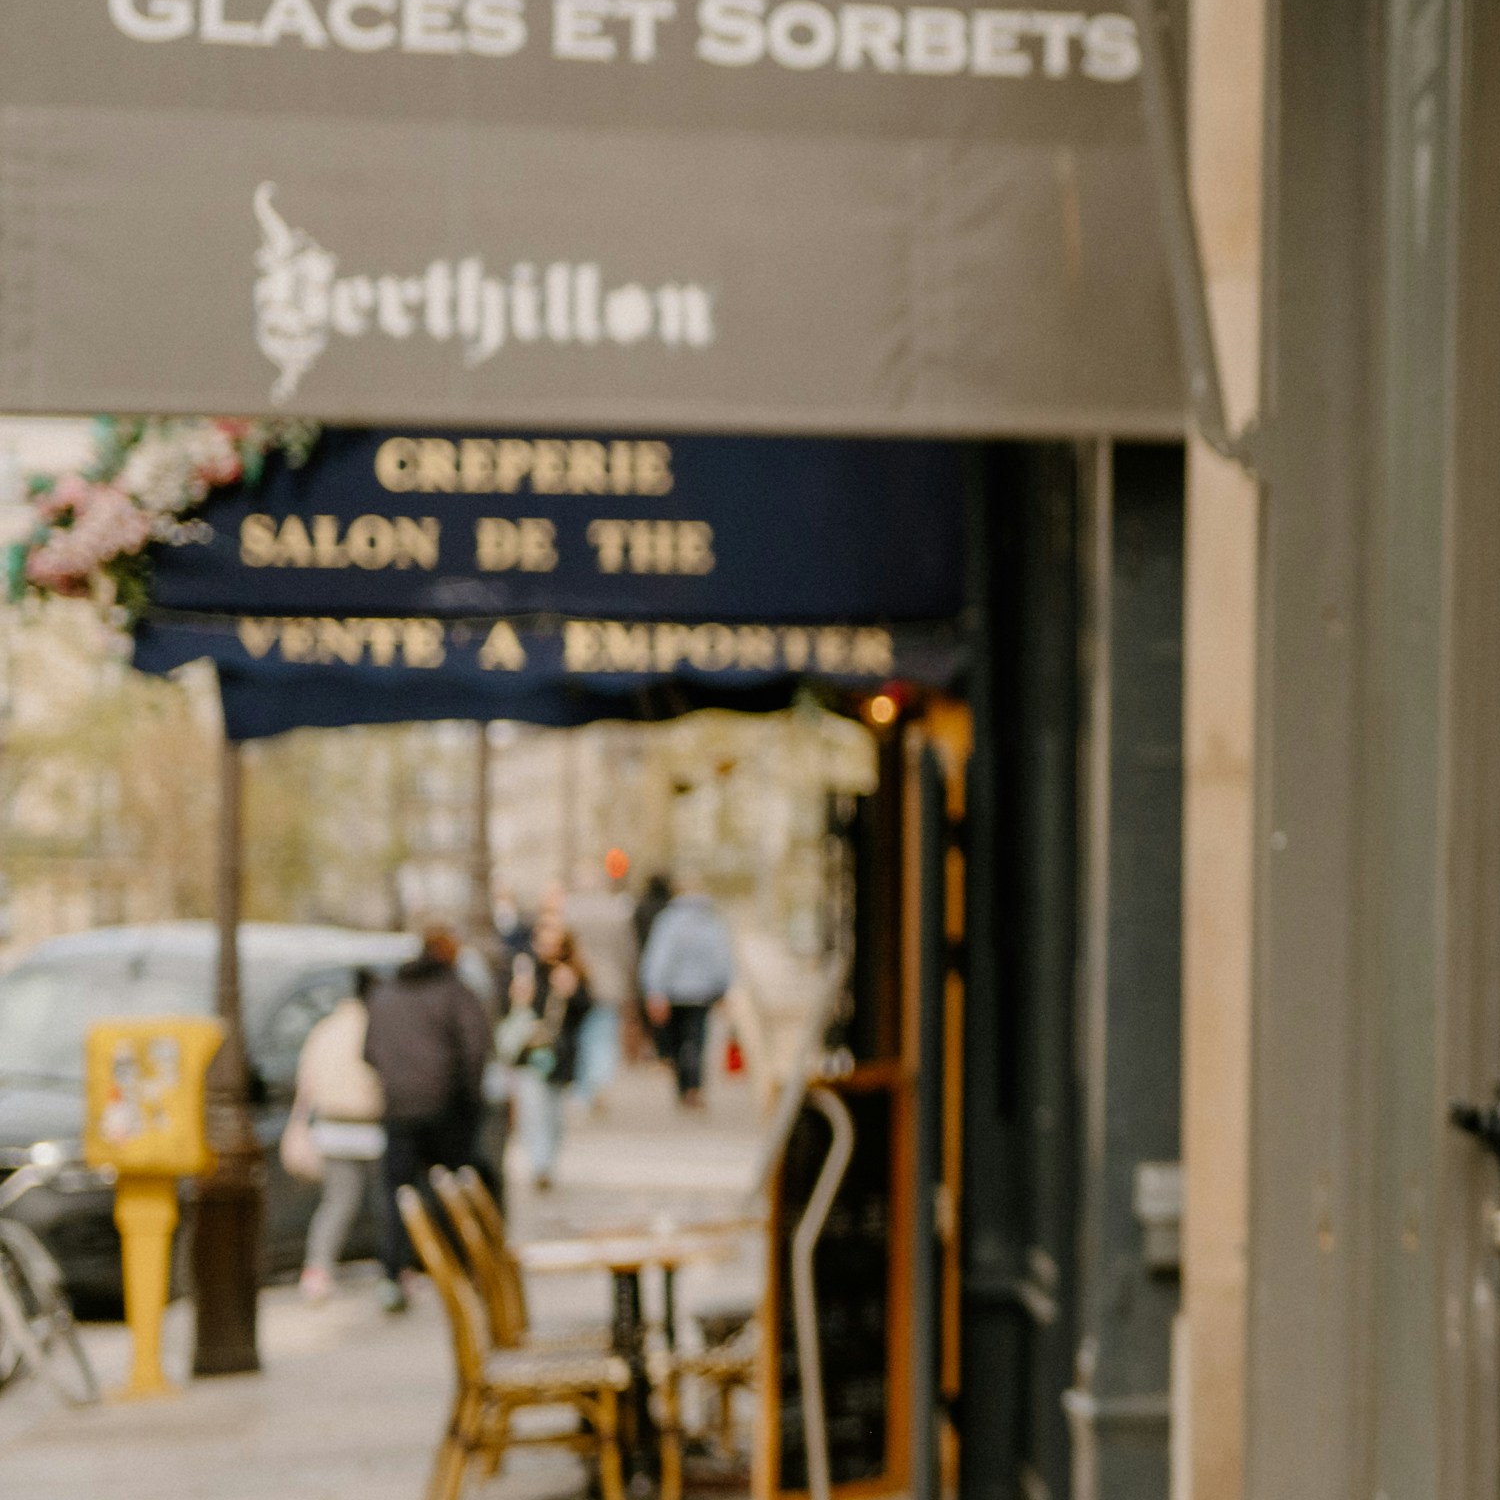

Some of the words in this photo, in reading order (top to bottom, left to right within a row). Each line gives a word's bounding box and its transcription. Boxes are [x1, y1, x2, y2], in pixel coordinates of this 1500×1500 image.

[374, 436, 675, 498] CREPERIE
[238, 512, 441, 571] SALON
[476, 516, 558, 574] DE
[589, 518, 716, 576] THE
[236, 616, 447, 670] VENTE
[479, 618, 526, 672] A
[563, 620, 894, 677] EMPORTER
